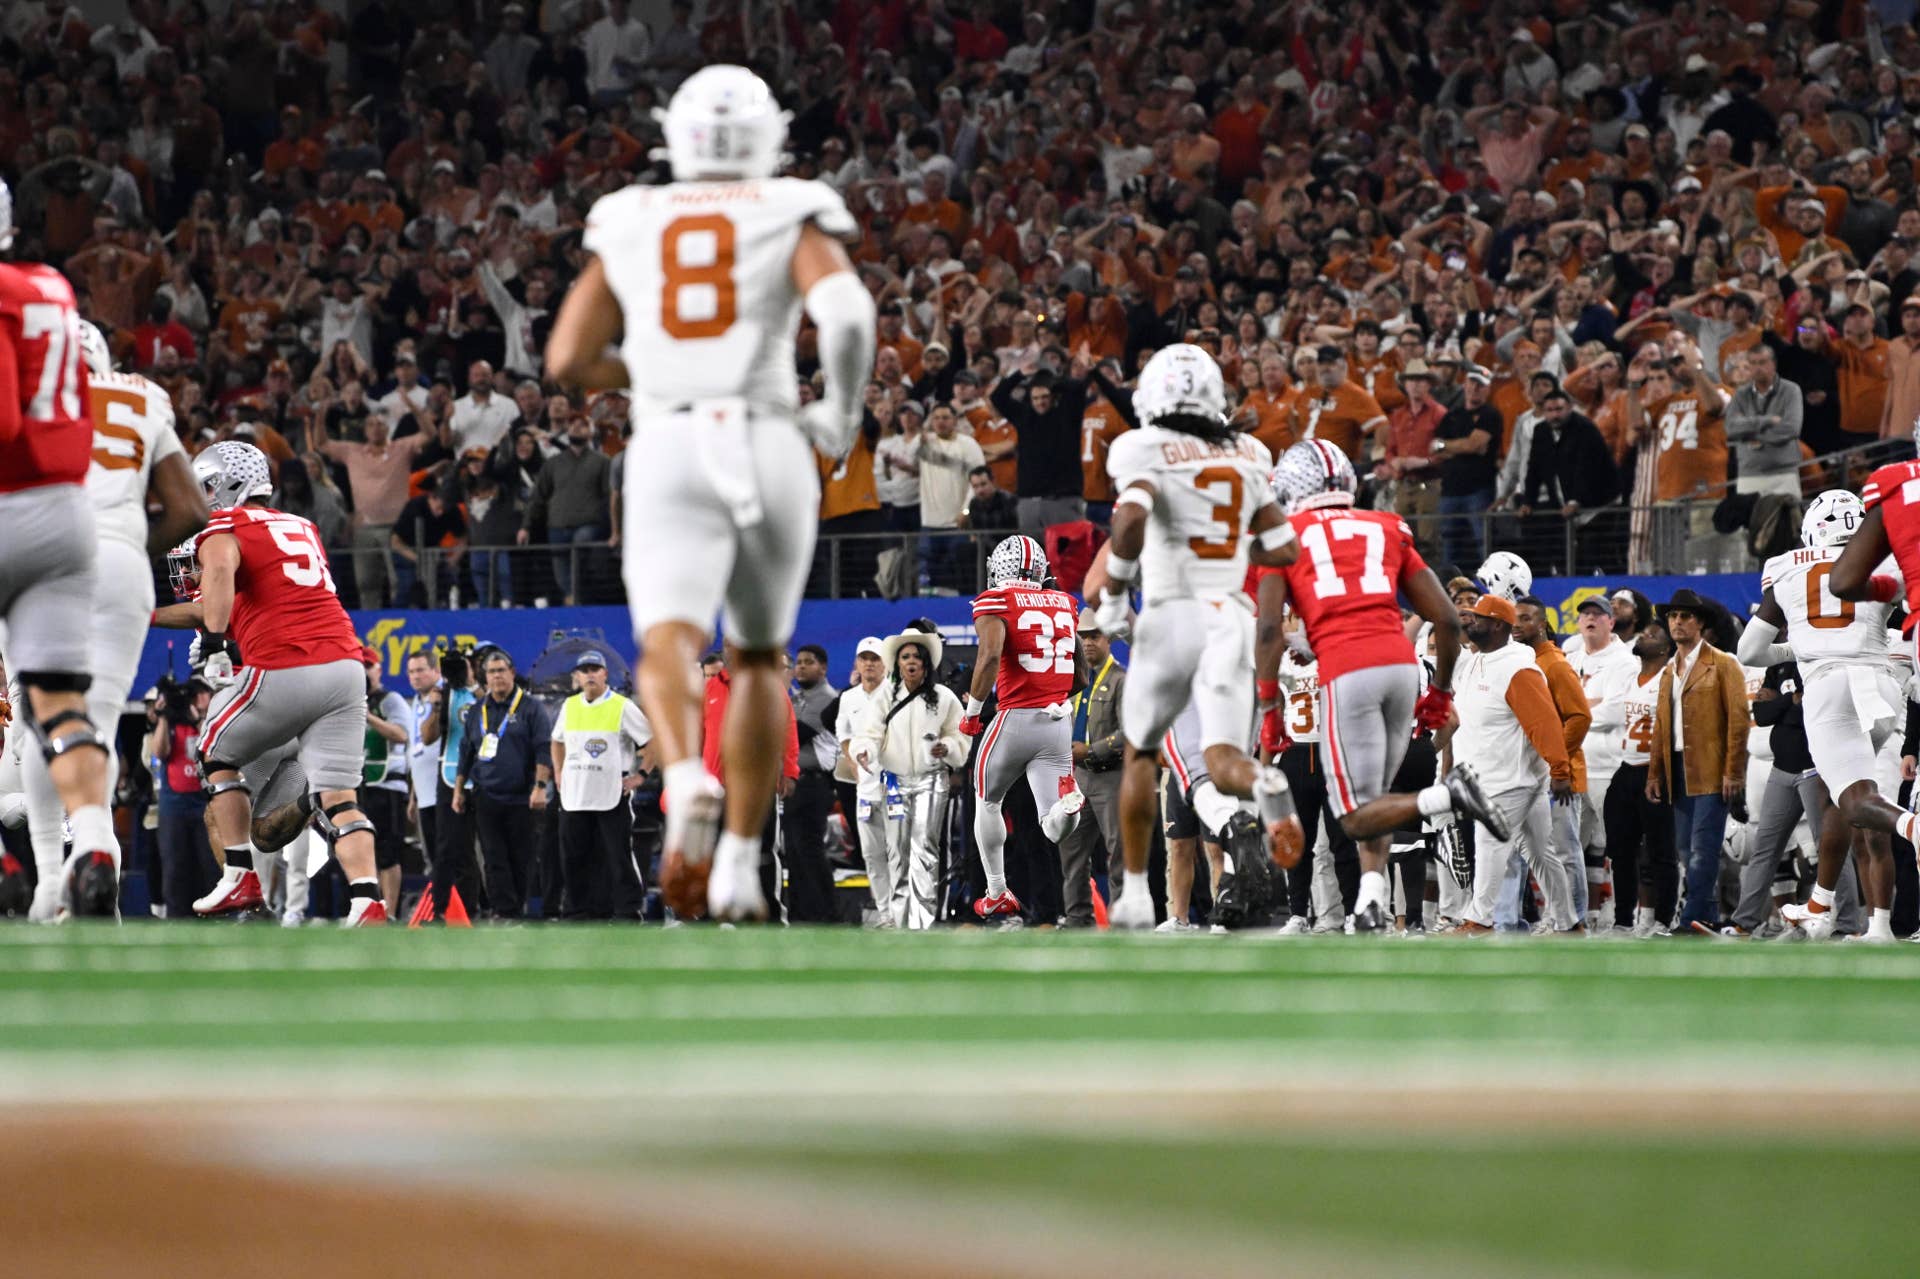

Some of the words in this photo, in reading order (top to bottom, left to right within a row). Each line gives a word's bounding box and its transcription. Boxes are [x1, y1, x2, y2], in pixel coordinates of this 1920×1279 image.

[660, 212, 737, 340] 8
[1182, 369, 1194, 395] 3
[1659, 412, 1698, 451] 34
[1190, 465, 1243, 560] 3
[1843, 511, 1855, 531] 0
[1300, 518, 1391, 600] 17
[1794, 550, 1833, 565] HILL
[1014, 592, 1071, 611] HENDERSON
[1806, 561, 1856, 629] 0
[1017, 610, 1075, 674] 32
